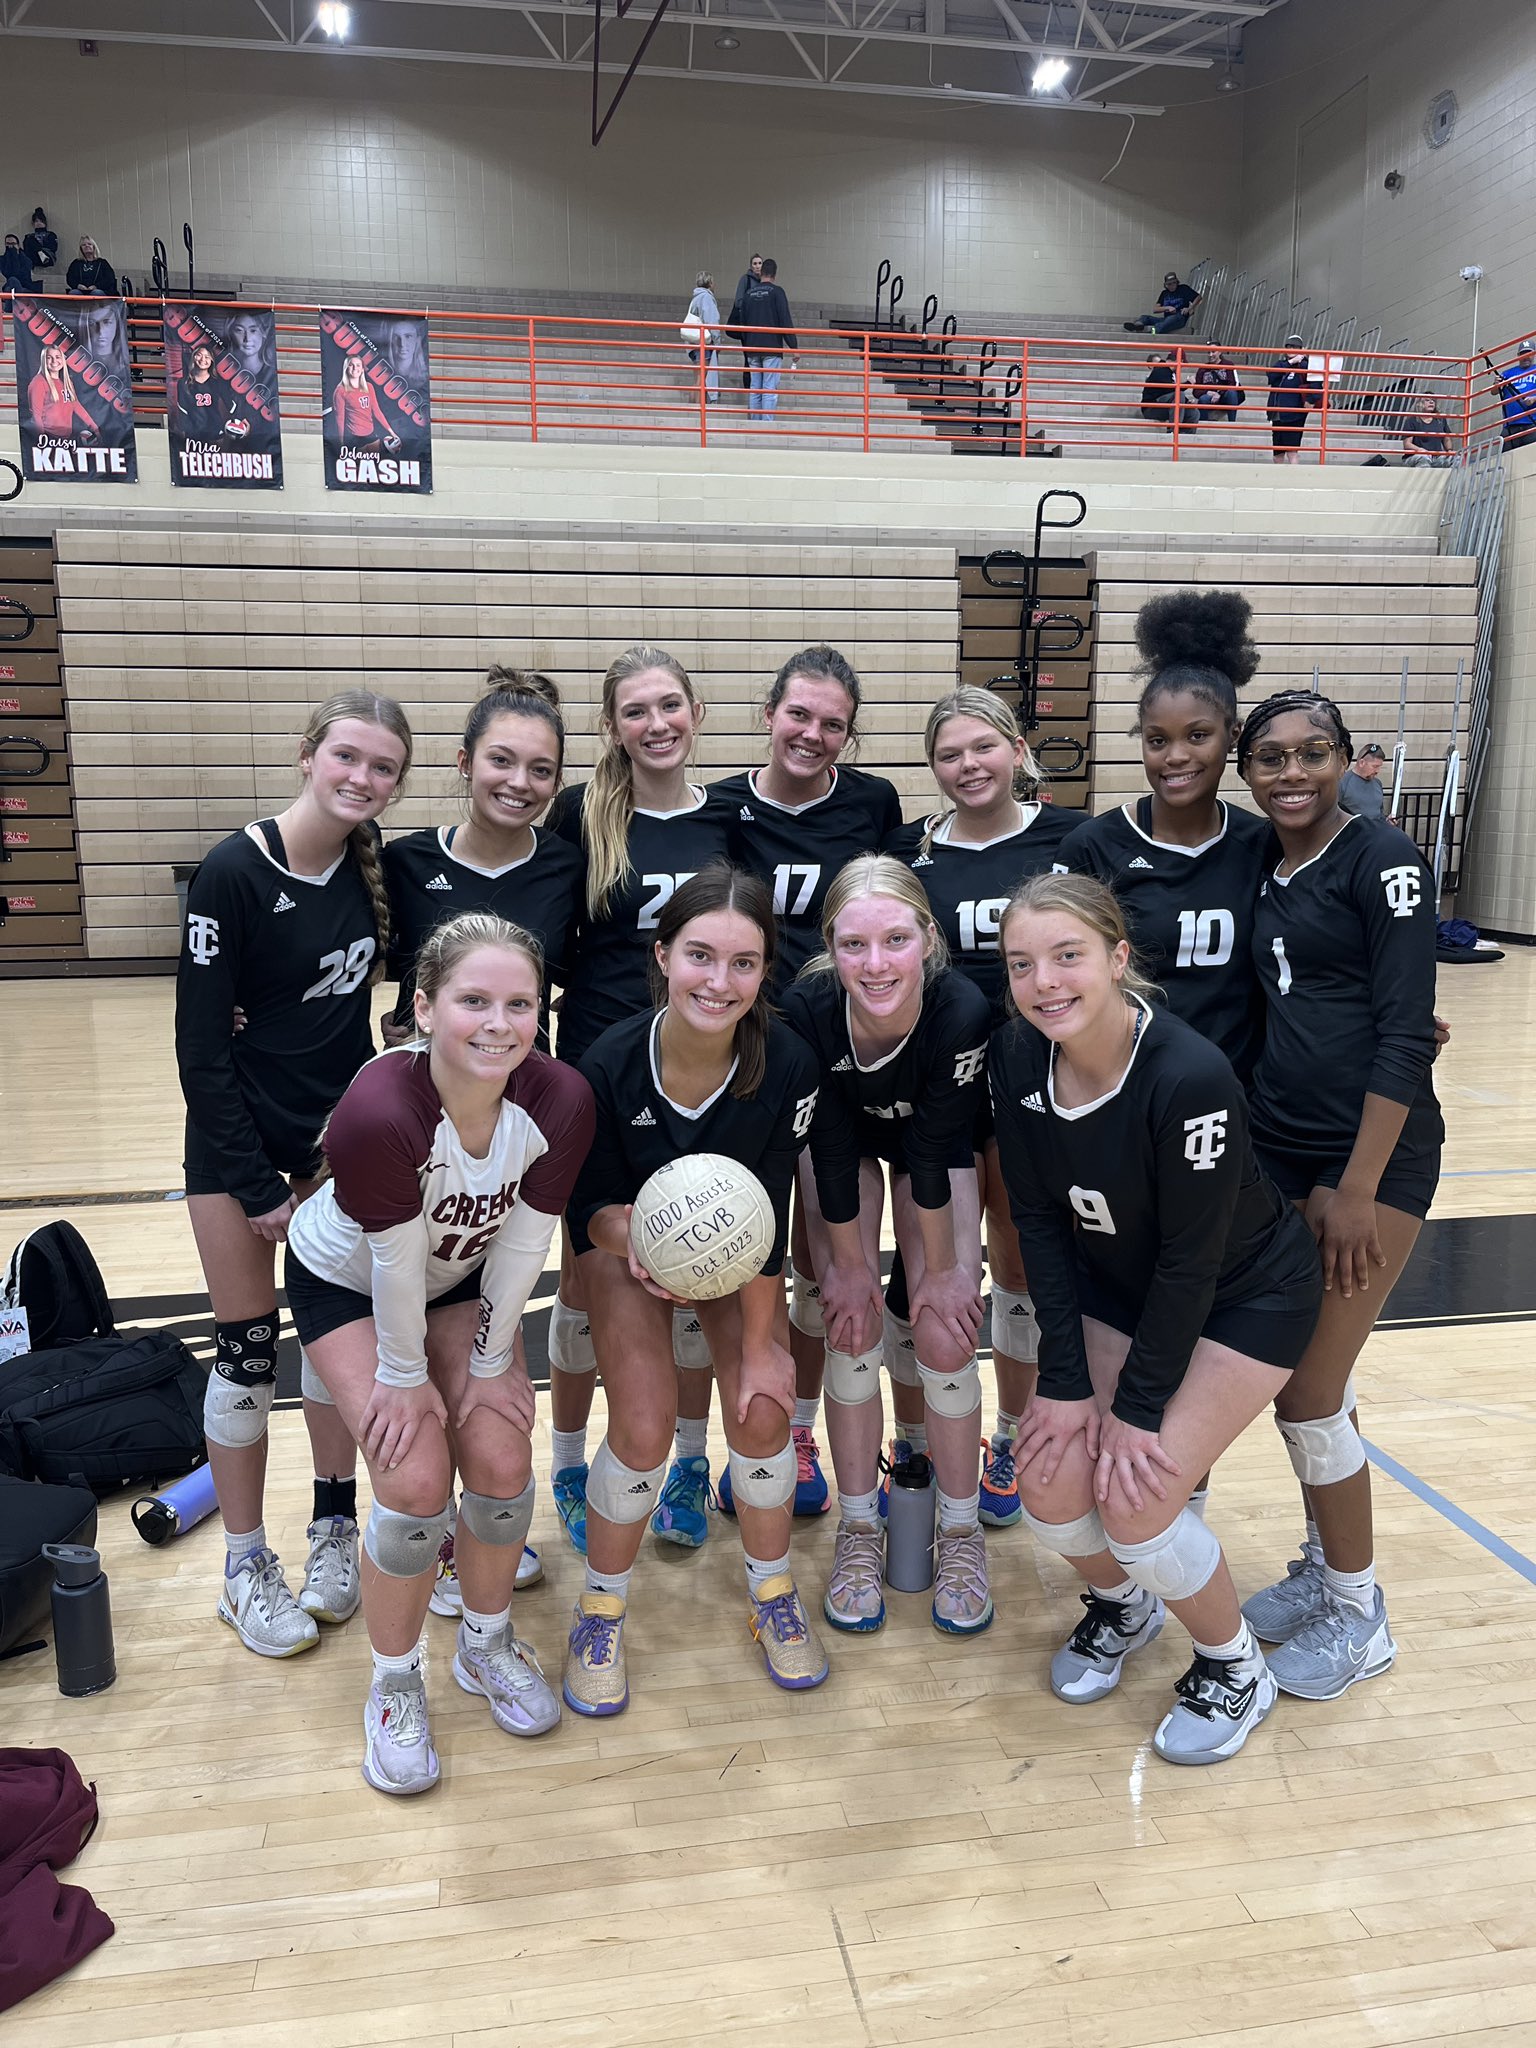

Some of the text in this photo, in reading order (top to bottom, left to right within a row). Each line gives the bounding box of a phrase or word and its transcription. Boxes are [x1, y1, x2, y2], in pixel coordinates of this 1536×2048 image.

[61, 324, 75, 338] 2024
[210, 332, 223, 346] 2024
[365, 338, 378, 352] 2024
[195, 393, 212, 407] 23
[37, 434, 77, 451] Daisy
[185, 437, 221, 454] Mia
[339, 445, 381, 462] Delaney
[32, 447, 127, 473] KATTE
[179, 451, 274, 479] TELECHBUSH
[336, 458, 421, 486] GASH
[911, 857, 935, 868] adidas
[425, 882, 453, 891] adidas
[637, 872, 699, 930] 2
[772, 863, 821, 915] 17
[1380, 866, 1421, 918] TC
[273, 900, 297, 914] adidas
[188, 913, 220, 966] TC
[955, 897, 1012, 951] 19
[1176, 908, 1235, 968] 10
[301, 936, 376, 1003] 28
[1271, 937, 1293, 996] 1
[631, 1118, 657, 1126] adidas
[1020, 1098, 1047, 1114] adidas
[1183, 1109, 1228, 1170] TC
[431, 1181, 519, 1229] CREEK
[645, 1178, 734, 1241] 1000 Assists
[1068, 1185, 1117, 1236] 9
[431, 1224, 501, 1262] 16
[674, 1206, 735, 1252] TCVB
[692, 1256, 724, 1278] Oct.
[722, 1230, 753, 1262] 2023
